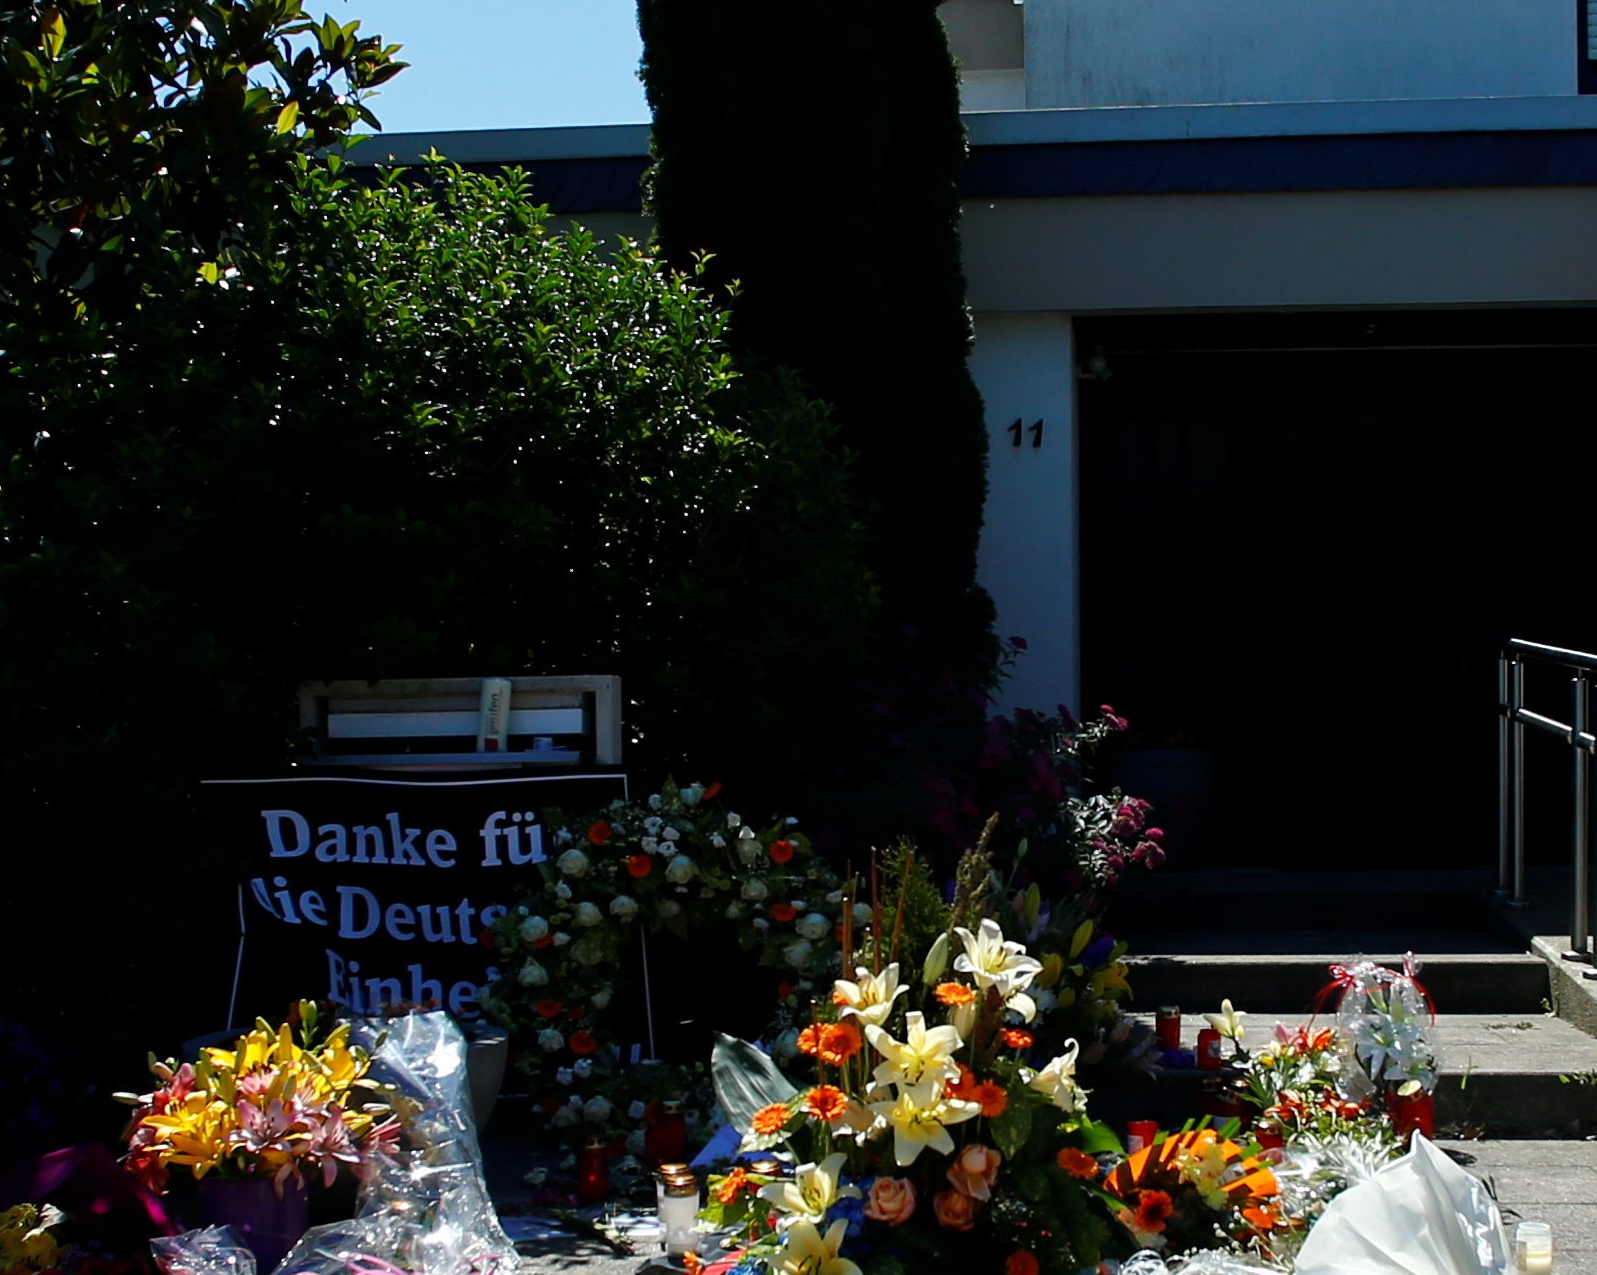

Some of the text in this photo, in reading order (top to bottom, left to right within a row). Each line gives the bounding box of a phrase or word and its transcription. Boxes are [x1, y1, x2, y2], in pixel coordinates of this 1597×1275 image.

[1007, 417, 1044, 448] 11
[260, 809, 548, 868] Danke fü
[325, 948, 504, 1019] Einhe
